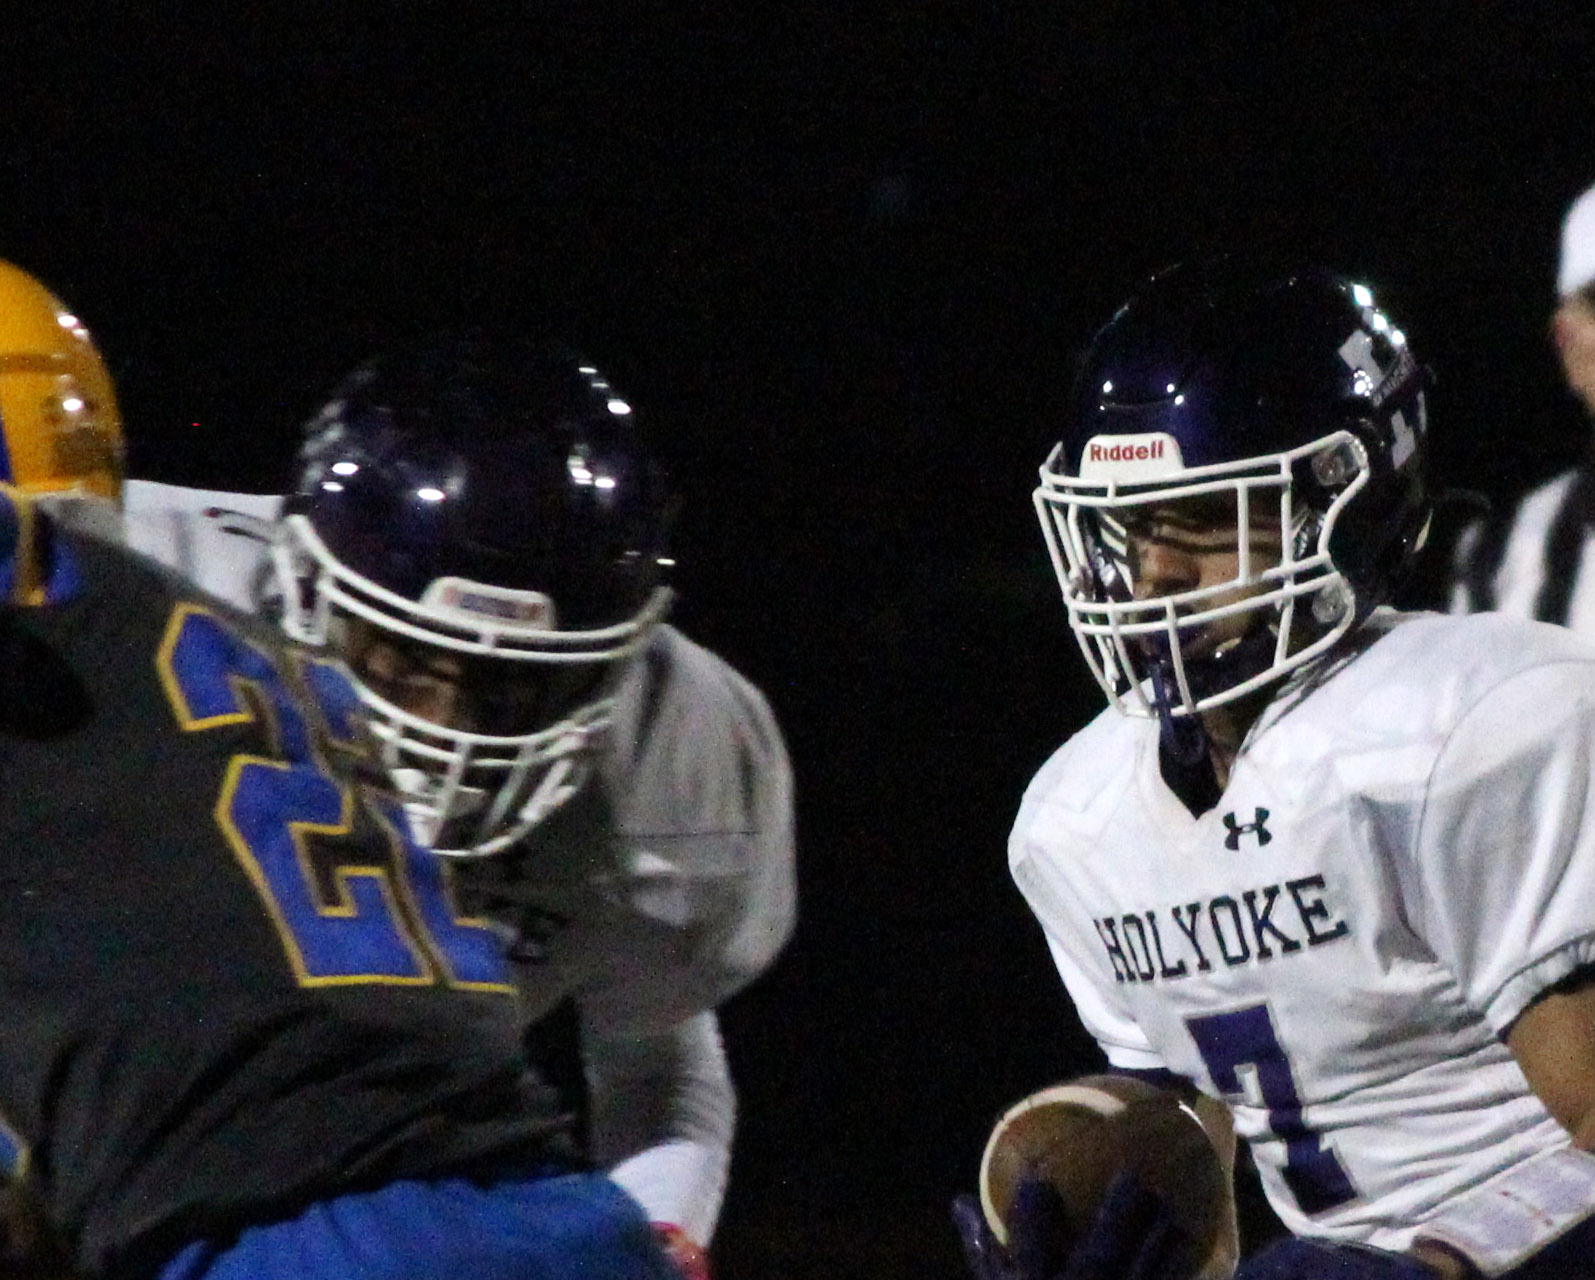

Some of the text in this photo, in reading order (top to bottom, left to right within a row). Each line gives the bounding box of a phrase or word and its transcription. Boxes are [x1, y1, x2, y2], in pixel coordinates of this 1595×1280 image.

[1089, 439, 1164, 462] Riddell
[1094, 873, 1349, 984] HOLYOKE
[1181, 1000, 1363, 1222] 7
